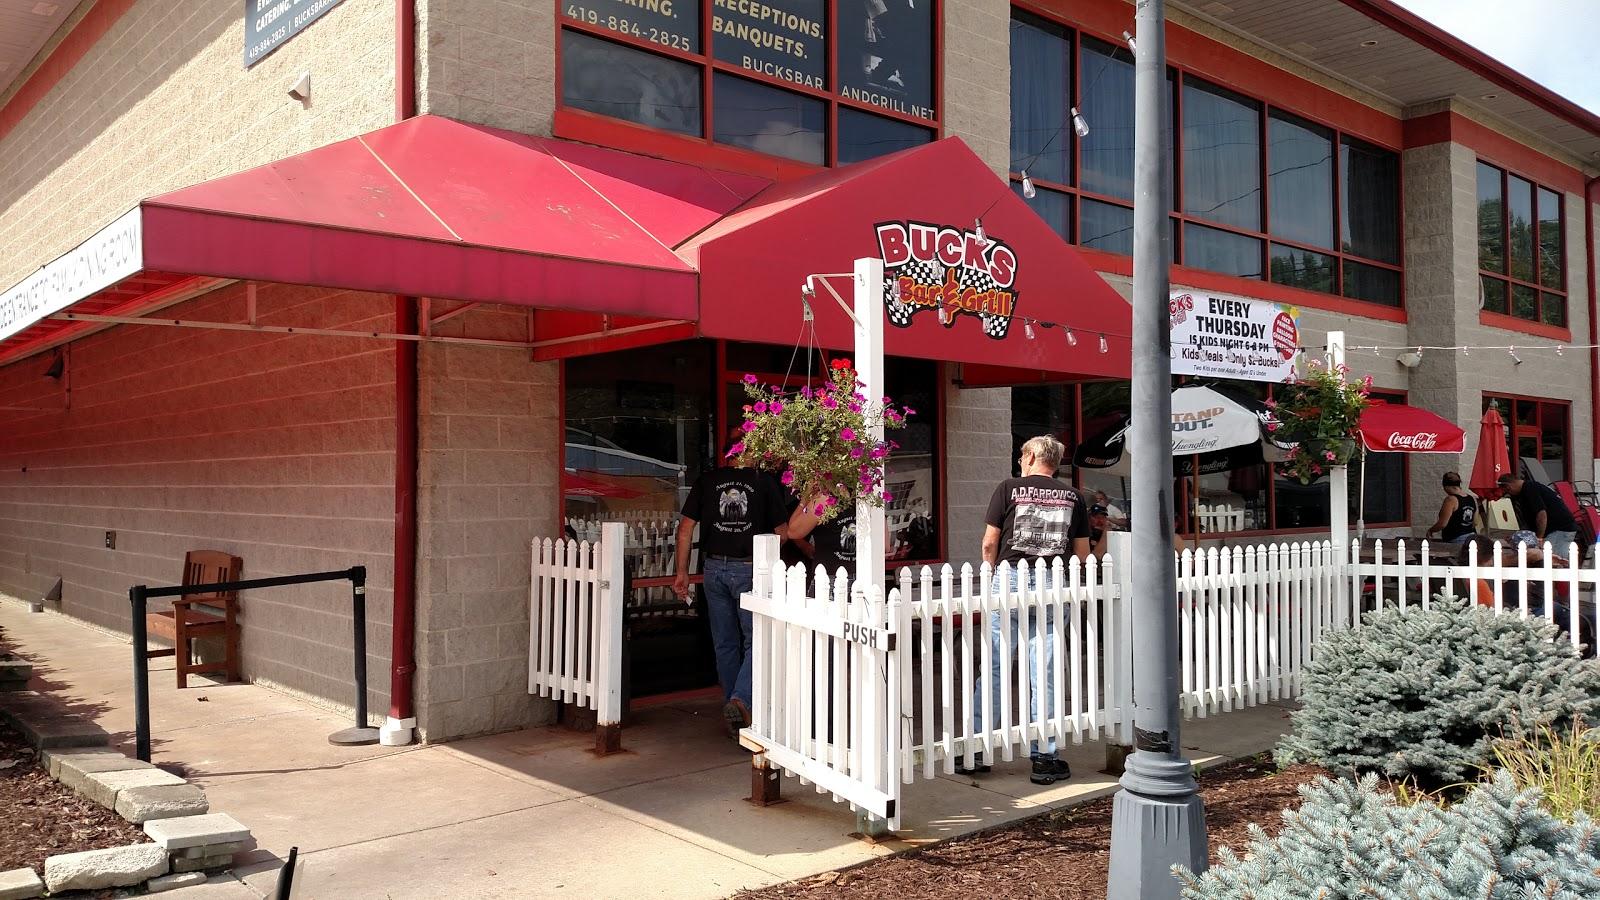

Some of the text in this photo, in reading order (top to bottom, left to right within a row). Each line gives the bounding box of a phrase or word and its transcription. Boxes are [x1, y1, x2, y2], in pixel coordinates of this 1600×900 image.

[255, 0, 291, 33] CATERING.
[567, 4, 690, 51] 419-884-2825
[714, 0, 825, 39] RECEPTIONS.
[712, 16, 808, 59] BANQUETS.
[876, 223, 1017, 288] BUCKS
[898, 276, 943, 306] Bar
[960, 286, 1013, 317] Grill
[1169, 294, 1194, 316] CKS
[1208, 297, 1251, 319] EVERY
[1195, 315, 1266, 340] THURSDAY
[1181, 347, 1200, 361] Kids
[1189, 335, 1198, 344] IS
[1199, 335, 1219, 348] KIDS
[1220, 338, 1245, 351] NIGHT
[1258, 343, 1269, 353] PM
[1172, 407, 1225, 422] TAND
[1387, 431, 1438, 450] Coca-Cola
[843, 621, 877, 649] PUSH
